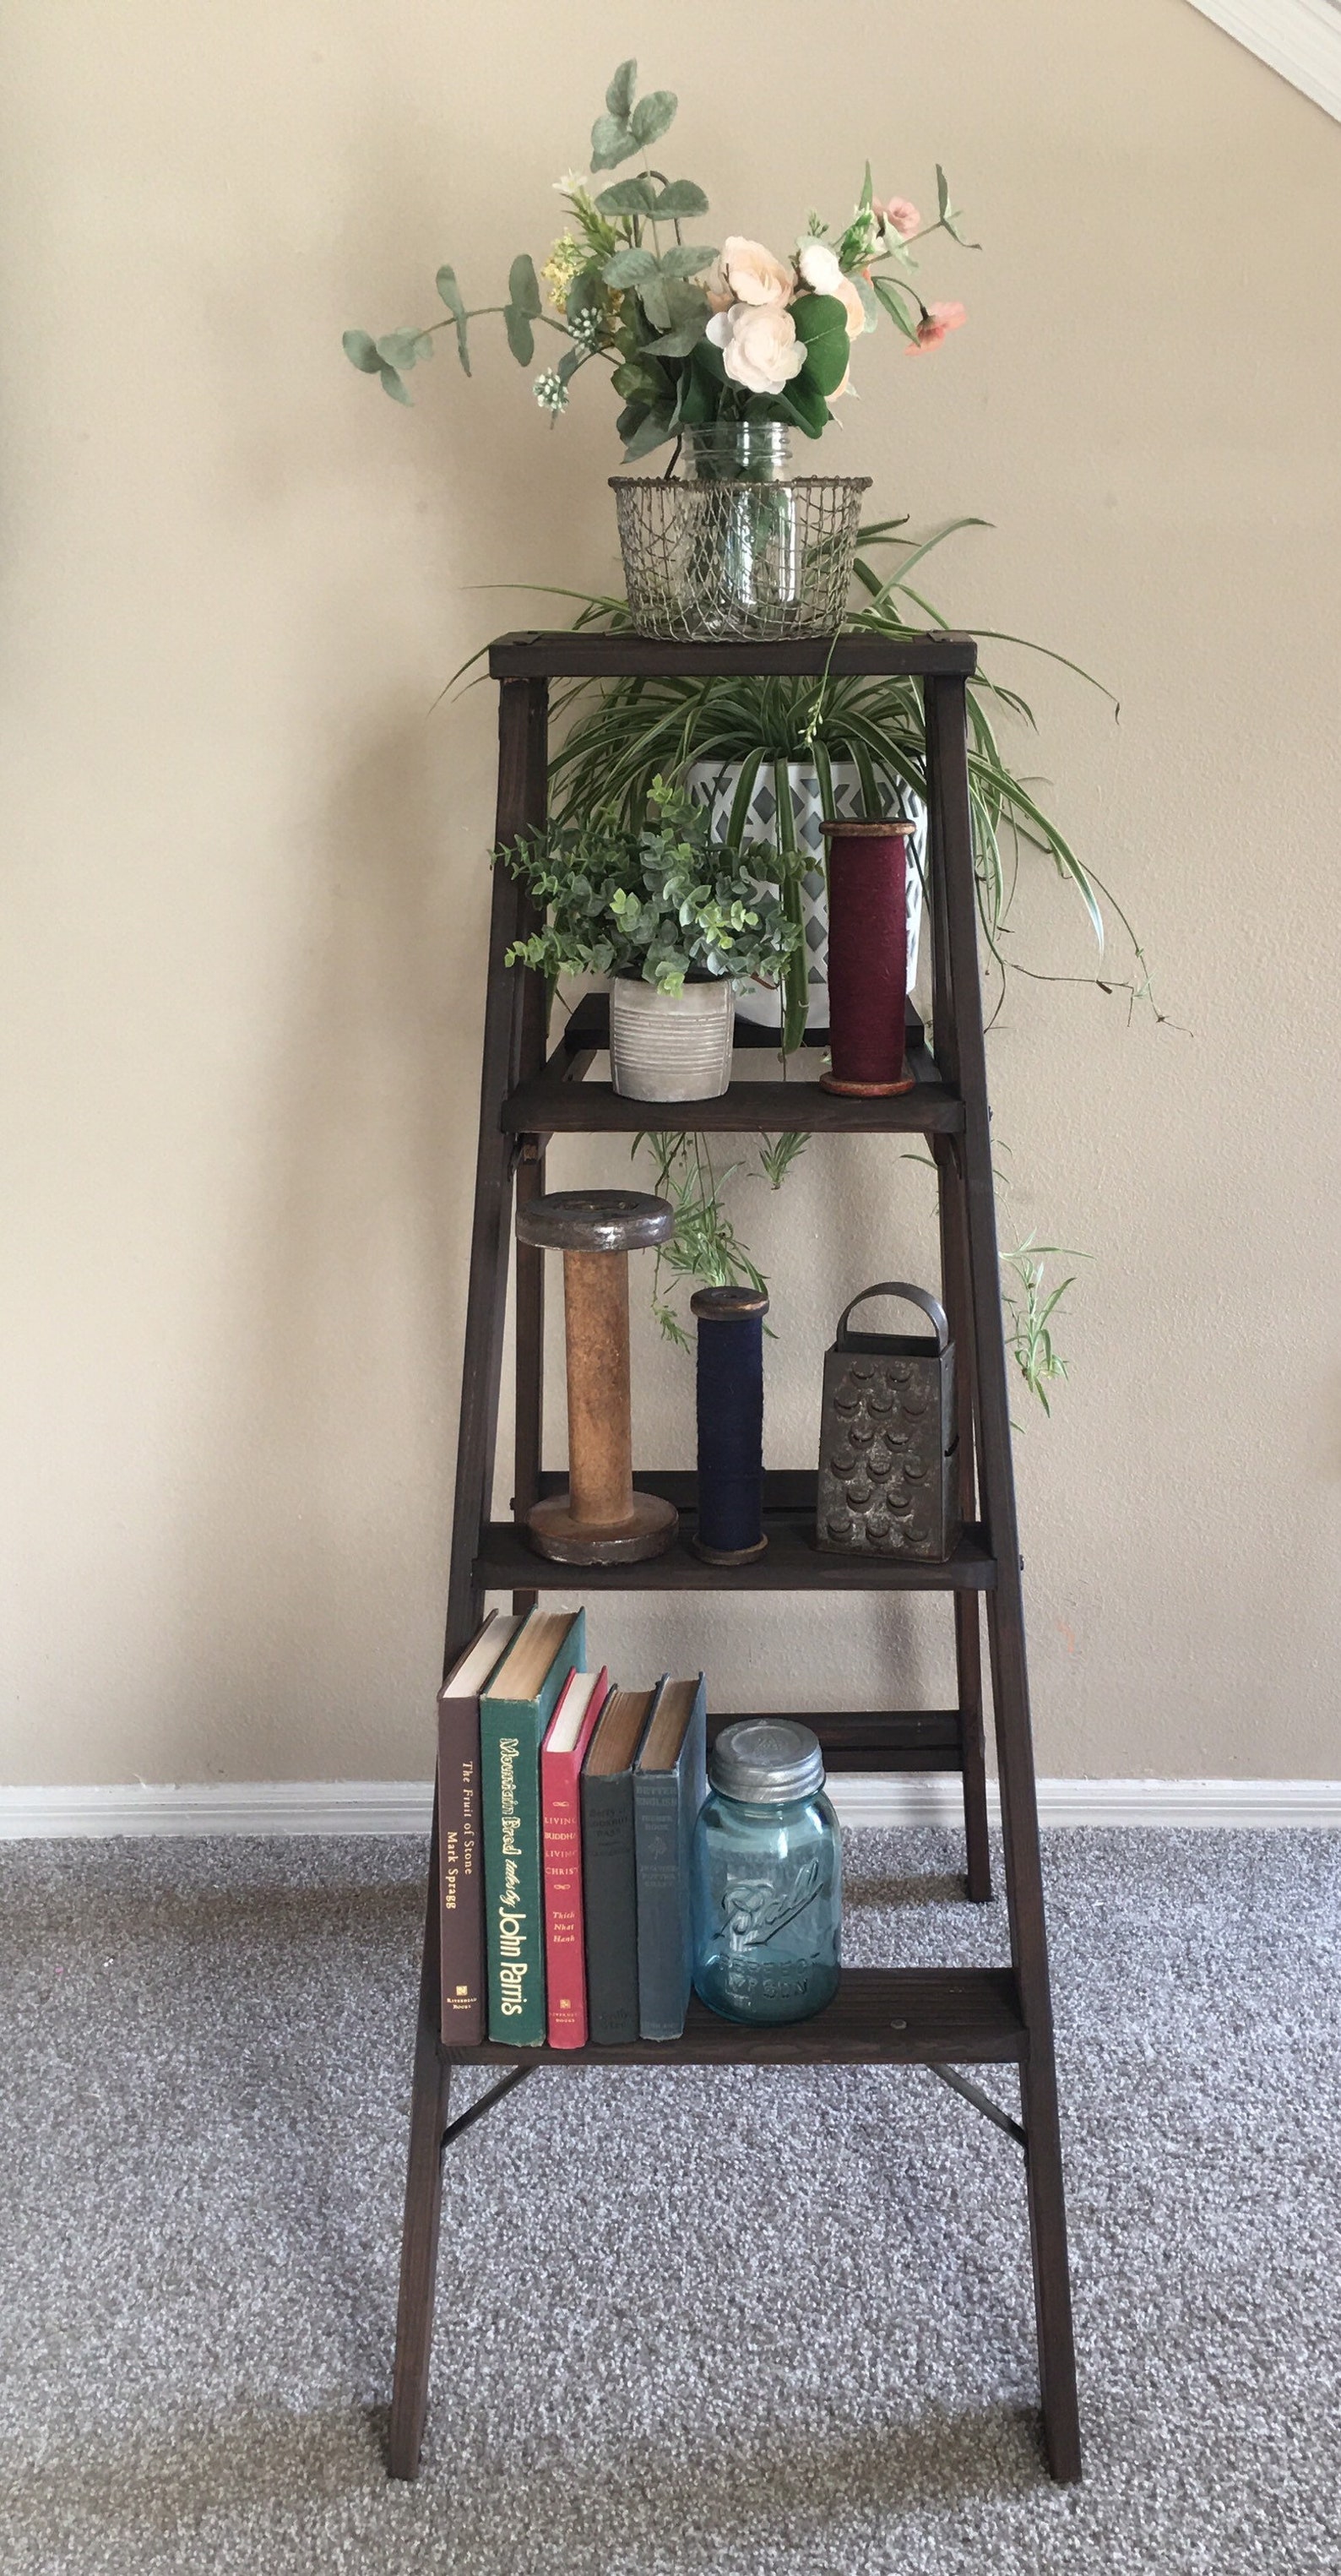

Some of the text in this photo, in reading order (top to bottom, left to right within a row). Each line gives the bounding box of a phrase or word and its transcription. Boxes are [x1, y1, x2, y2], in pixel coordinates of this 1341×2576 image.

[499, 1737, 518, 1815] Mountain
[463, 1761, 475, 1875] The Fruit of Stone
[502, 1817, 522, 1856] Bred
[446, 1831, 459, 1910] Mark Spragg
[499, 1907, 527, 1957] John
[500, 1962, 528, 2015] Parris
